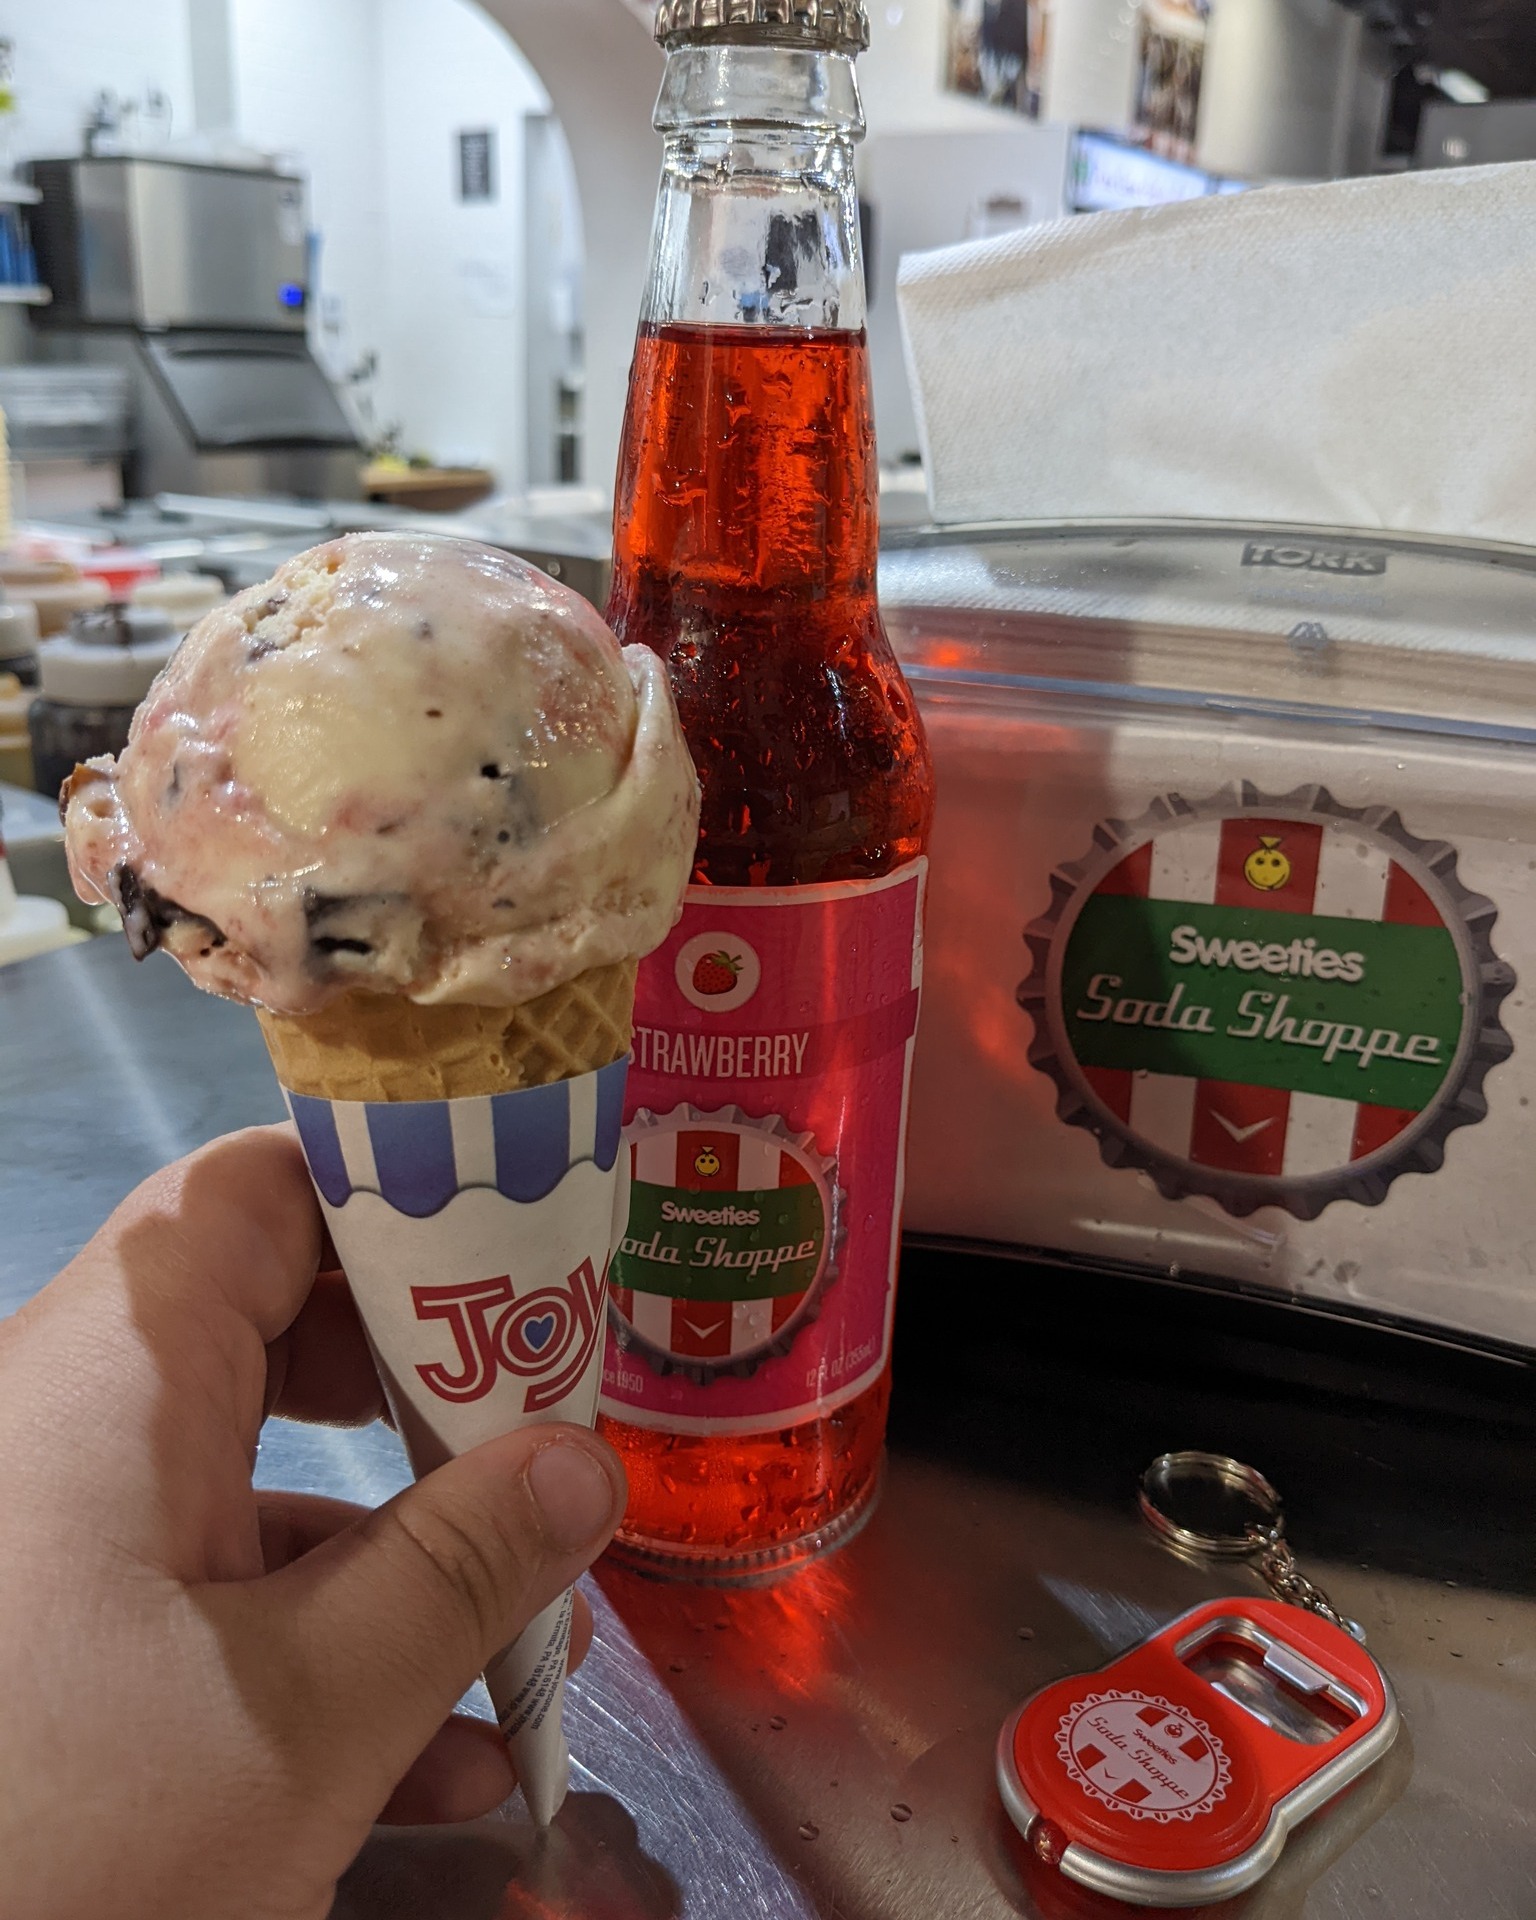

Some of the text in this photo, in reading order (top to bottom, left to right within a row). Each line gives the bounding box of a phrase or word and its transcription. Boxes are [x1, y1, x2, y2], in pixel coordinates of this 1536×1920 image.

[1249, 545, 1377, 572] TORK
[1169, 925, 1365, 982] Sweeties
[1075, 974, 1445, 1069] Soda Shoppe
[661, 1201, 761, 1226] Sweeties
[620, 1231, 817, 1276] oda Shoppe
[1087, 1716, 1190, 1800] Soda Shoppe
